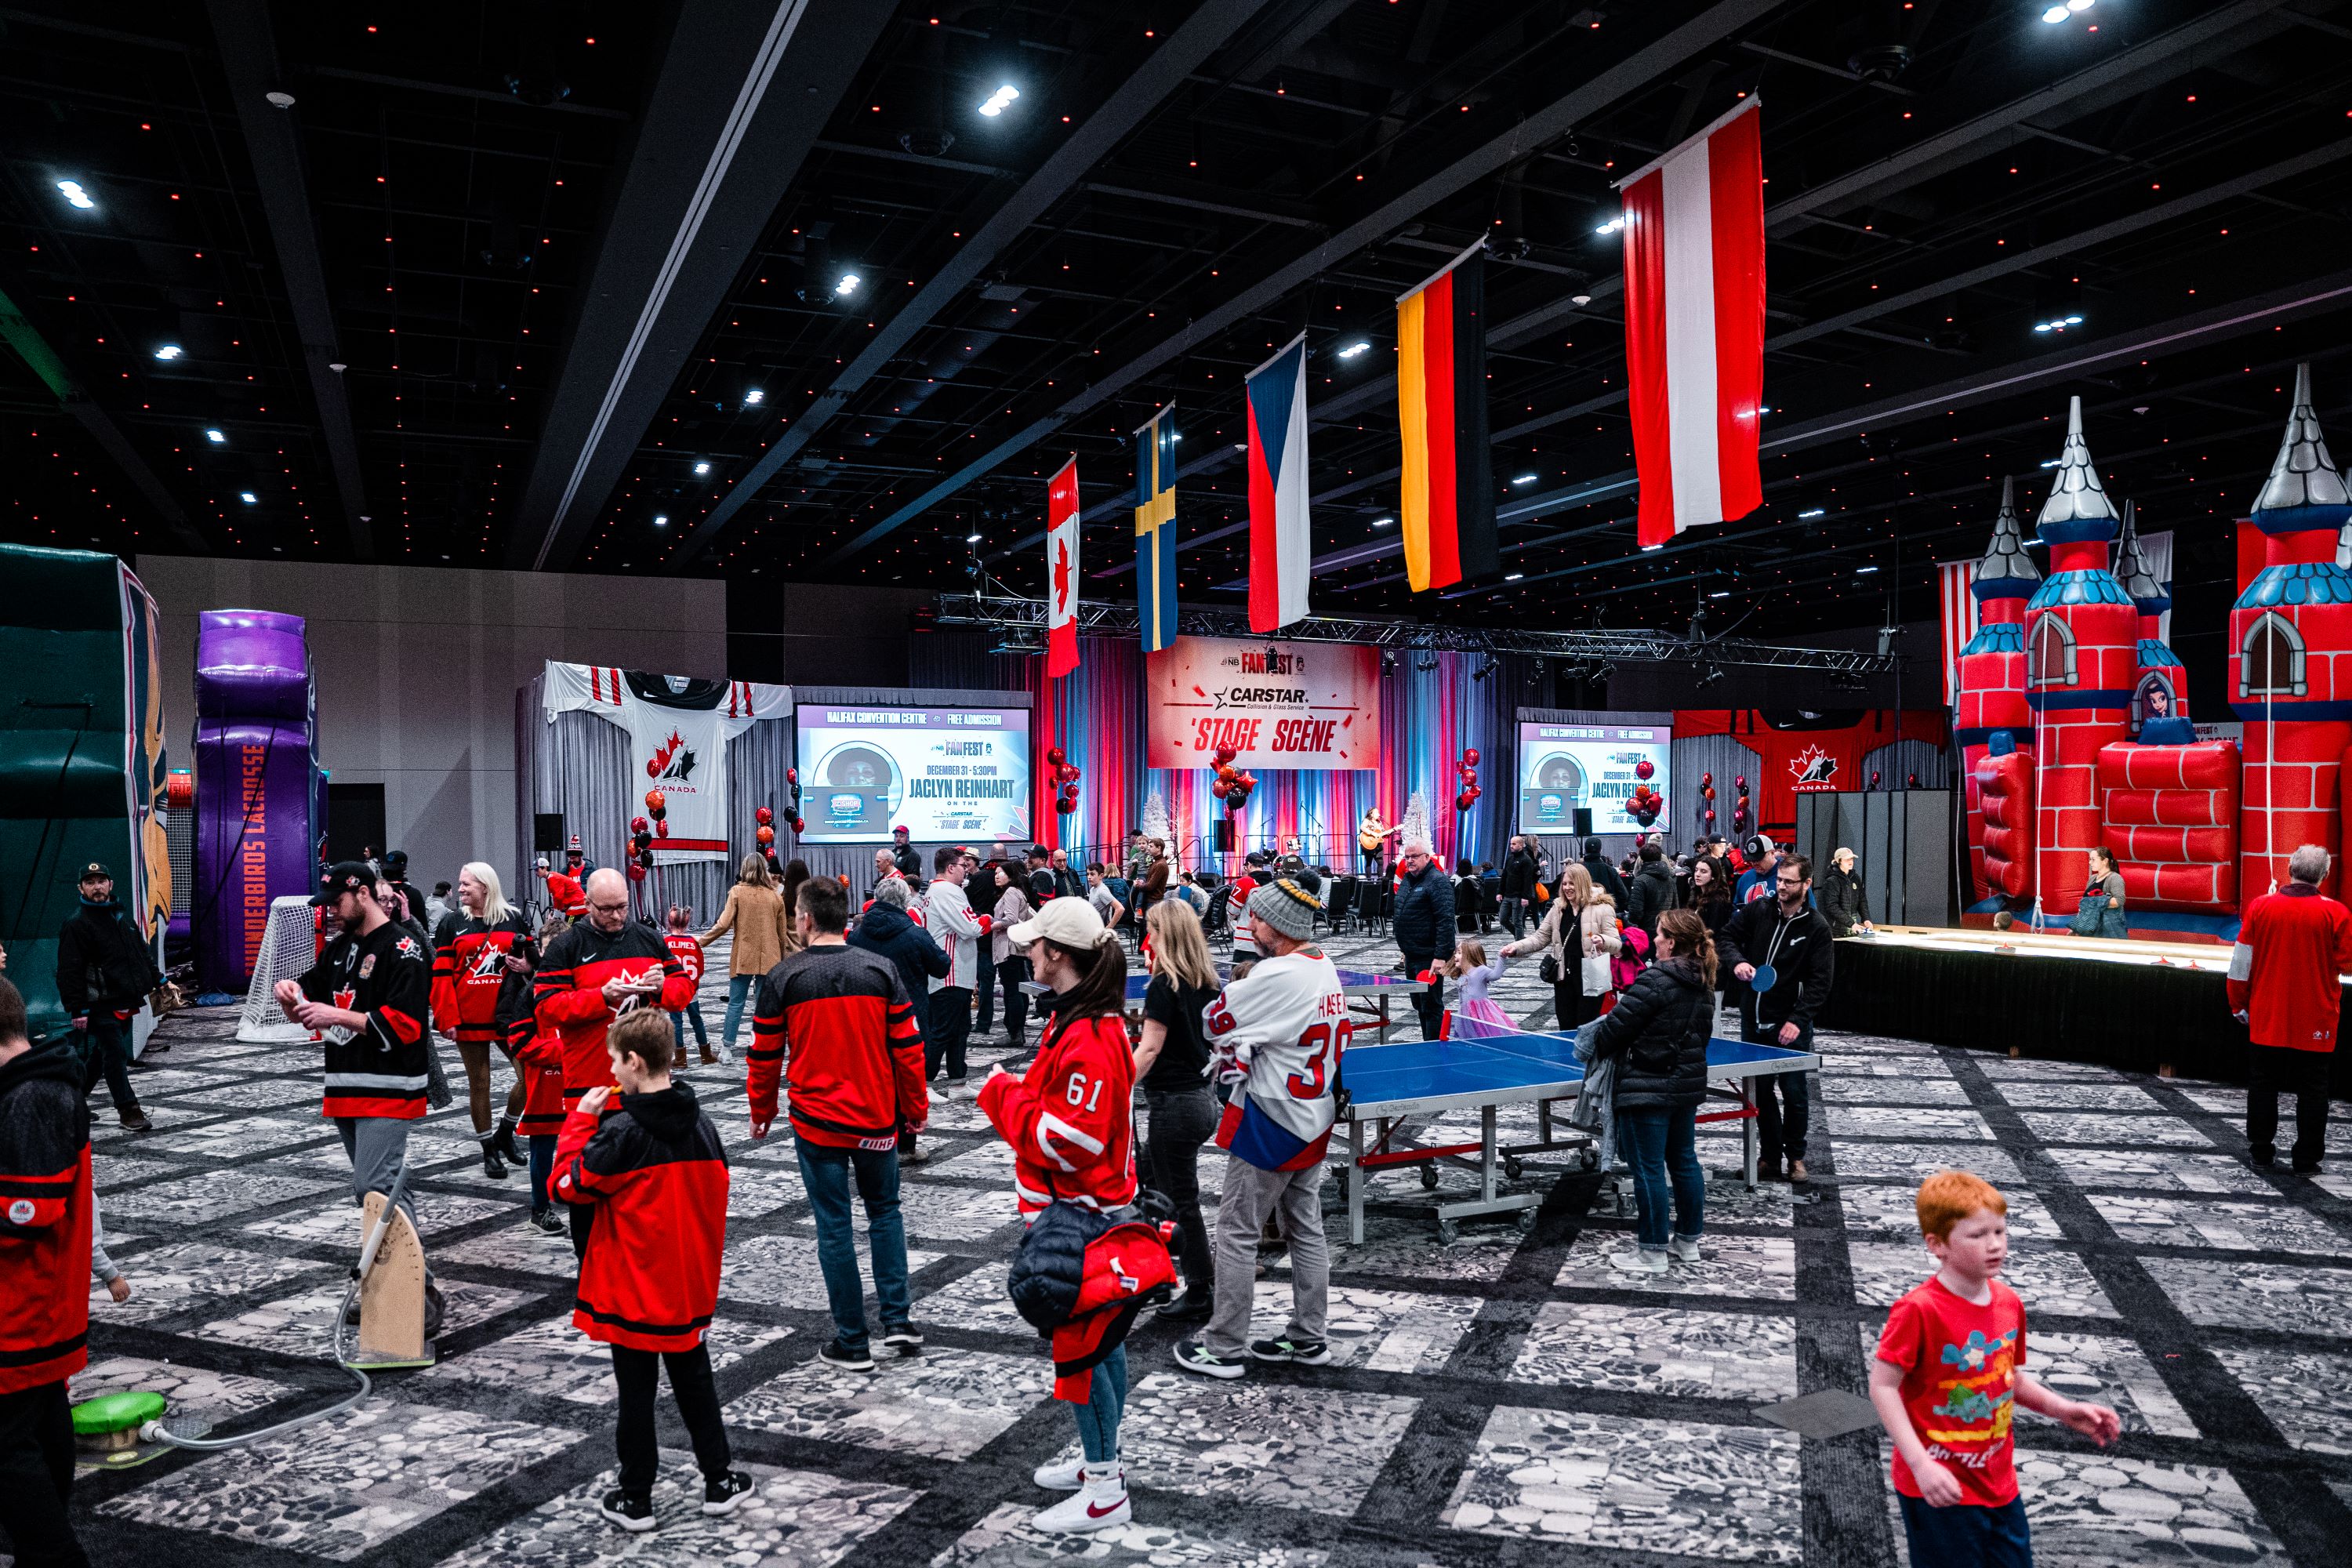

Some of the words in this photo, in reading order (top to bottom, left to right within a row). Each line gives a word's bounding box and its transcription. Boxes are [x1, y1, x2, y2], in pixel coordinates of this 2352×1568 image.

[1241, 652, 1293, 674] FANST
[1230, 687, 1305, 703] CARSTAR
[827, 711, 855, 723] HALIFAX
[856, 712, 901, 724] CONVENTION
[901, 713, 927, 724] CENTRE
[947, 713, 963, 725] FREE
[964, 714, 1002, 726] ADMISSION
[1194, 717, 1262, 751] STAGE
[1271, 715, 1338, 752] SCÈNE
[1539, 728, 1559, 738] HALIFAX
[927, 765, 960, 775] DECEMBER
[960, 765, 968, 775] 31
[972, 765, 997, 775] 5:30PM
[242, 744, 265, 834] LACROSSE
[654, 785, 696, 793] CANADA
[909, 779, 953, 798] JACLYN
[955, 779, 1014, 798] REINHART
[1592, 782, 1621, 798] JACLYN
[941, 819, 960, 829] STAGE
[668, 941, 696, 950] KLIMES
[1066, 1072, 1104, 1112] 61
[869, 1138, 893, 1149] IIHF
